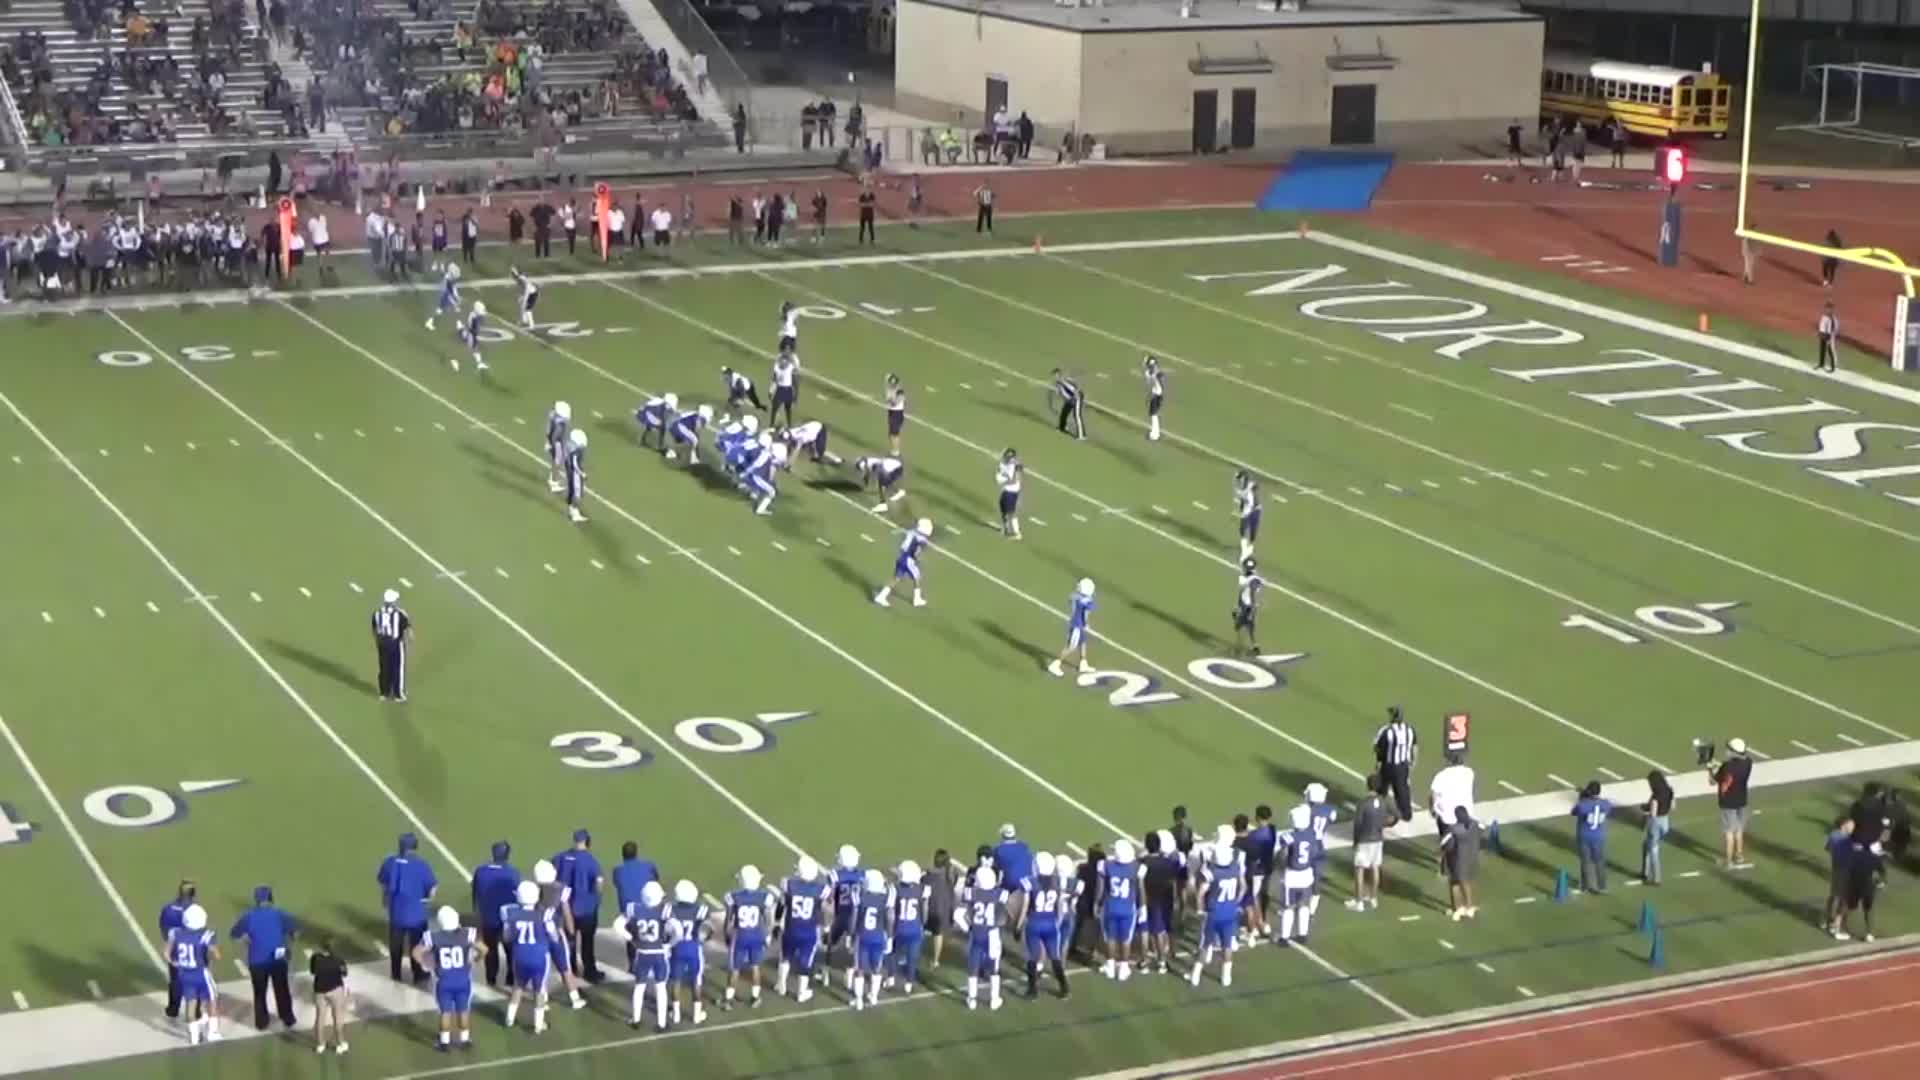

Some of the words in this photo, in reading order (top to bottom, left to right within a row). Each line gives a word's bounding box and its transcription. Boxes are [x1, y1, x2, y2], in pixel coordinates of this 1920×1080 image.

[1667, 149, 1683, 182] 6
[1298, 841, 1310, 864] 5
[1110, 877, 1130, 899] 54
[864, 906, 878, 930] 6
[899, 898, 918, 920] 16
[973, 902, 995, 926] 24
[515, 920, 536, 944] 71
[636, 919, 659, 942] 23
[178, 943, 197, 968] 21
[439, 946, 465, 969] 60
